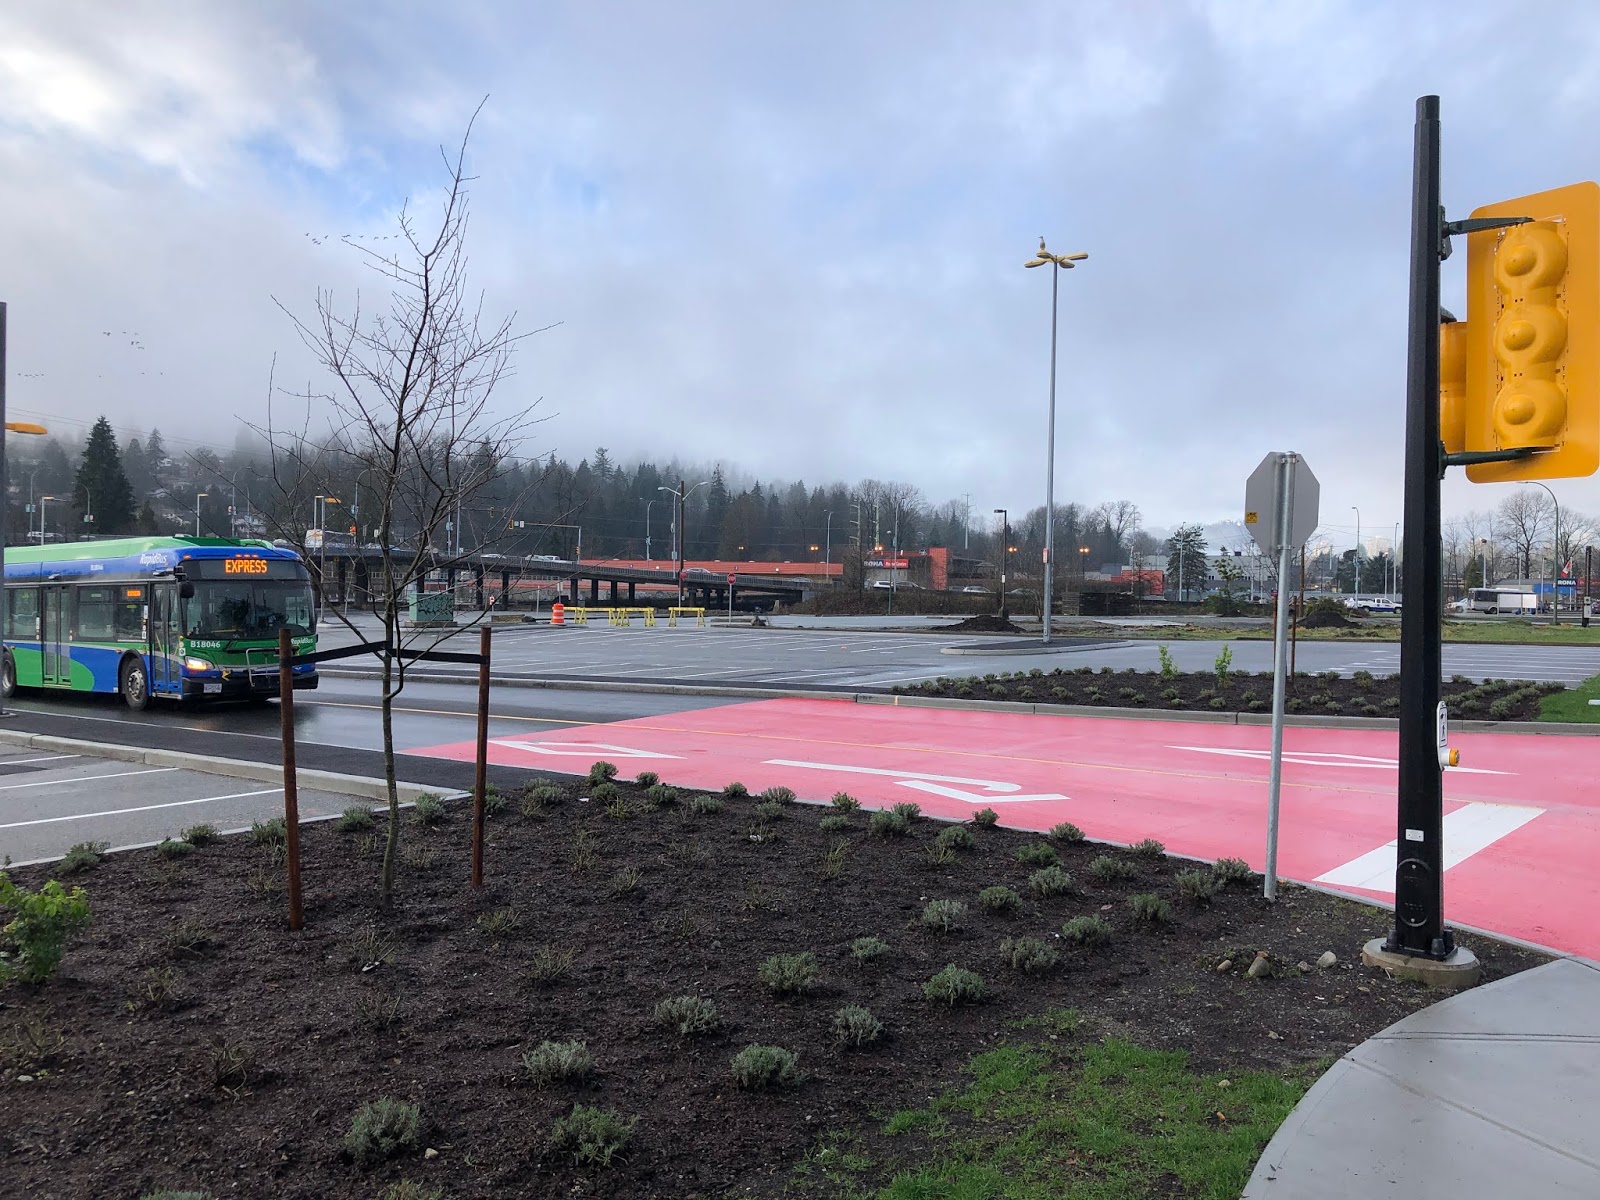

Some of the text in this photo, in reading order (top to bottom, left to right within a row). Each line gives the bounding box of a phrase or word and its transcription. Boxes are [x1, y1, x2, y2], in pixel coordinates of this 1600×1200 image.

[140, 553, 167, 566] RapidBus
[225, 559, 267, 573] EXPRESS
[190, 640, 221, 648] B18046
[291, 637, 313, 645] RapidBus
